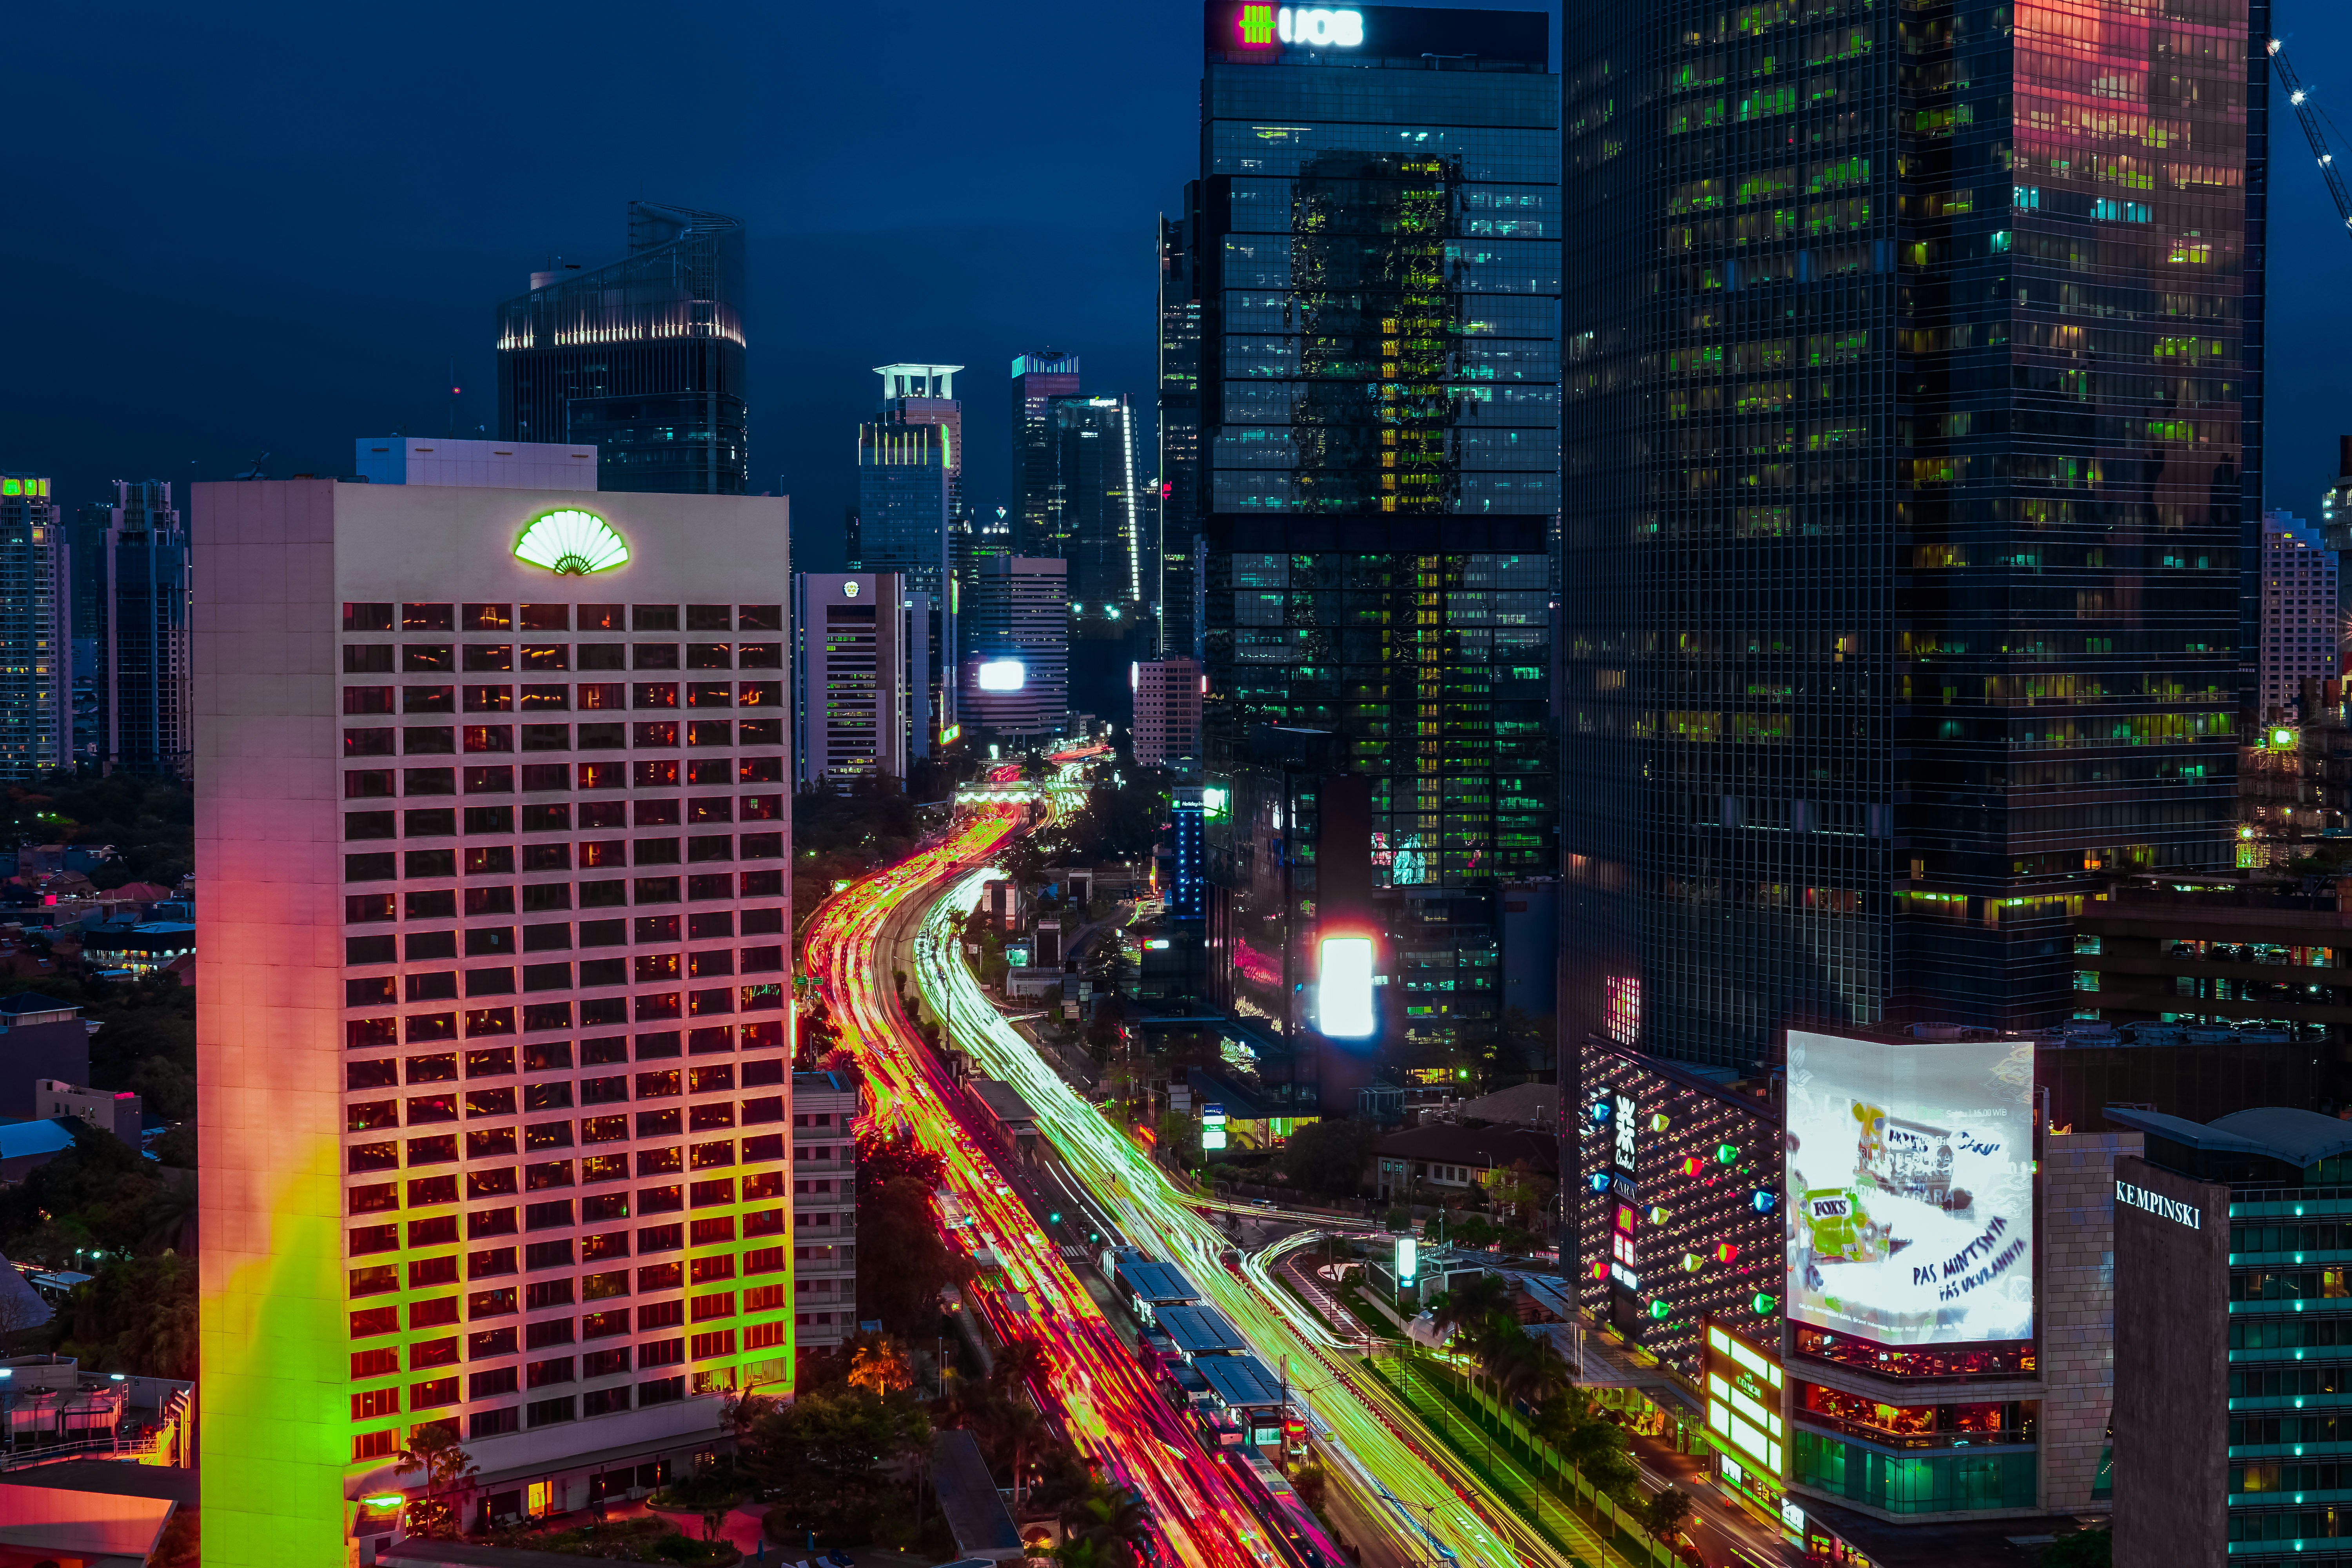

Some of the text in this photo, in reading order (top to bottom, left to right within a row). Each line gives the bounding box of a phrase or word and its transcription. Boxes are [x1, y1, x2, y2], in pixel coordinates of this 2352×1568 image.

[1278, 8, 1363, 45] UOB
[1613, 1178, 1635, 1199] ZARA
[2116, 1180, 2200, 1229] KEMPINSKI
[1913, 1264, 1936, 1285] PAS
[1736, 1376, 1761, 1398] COACH
